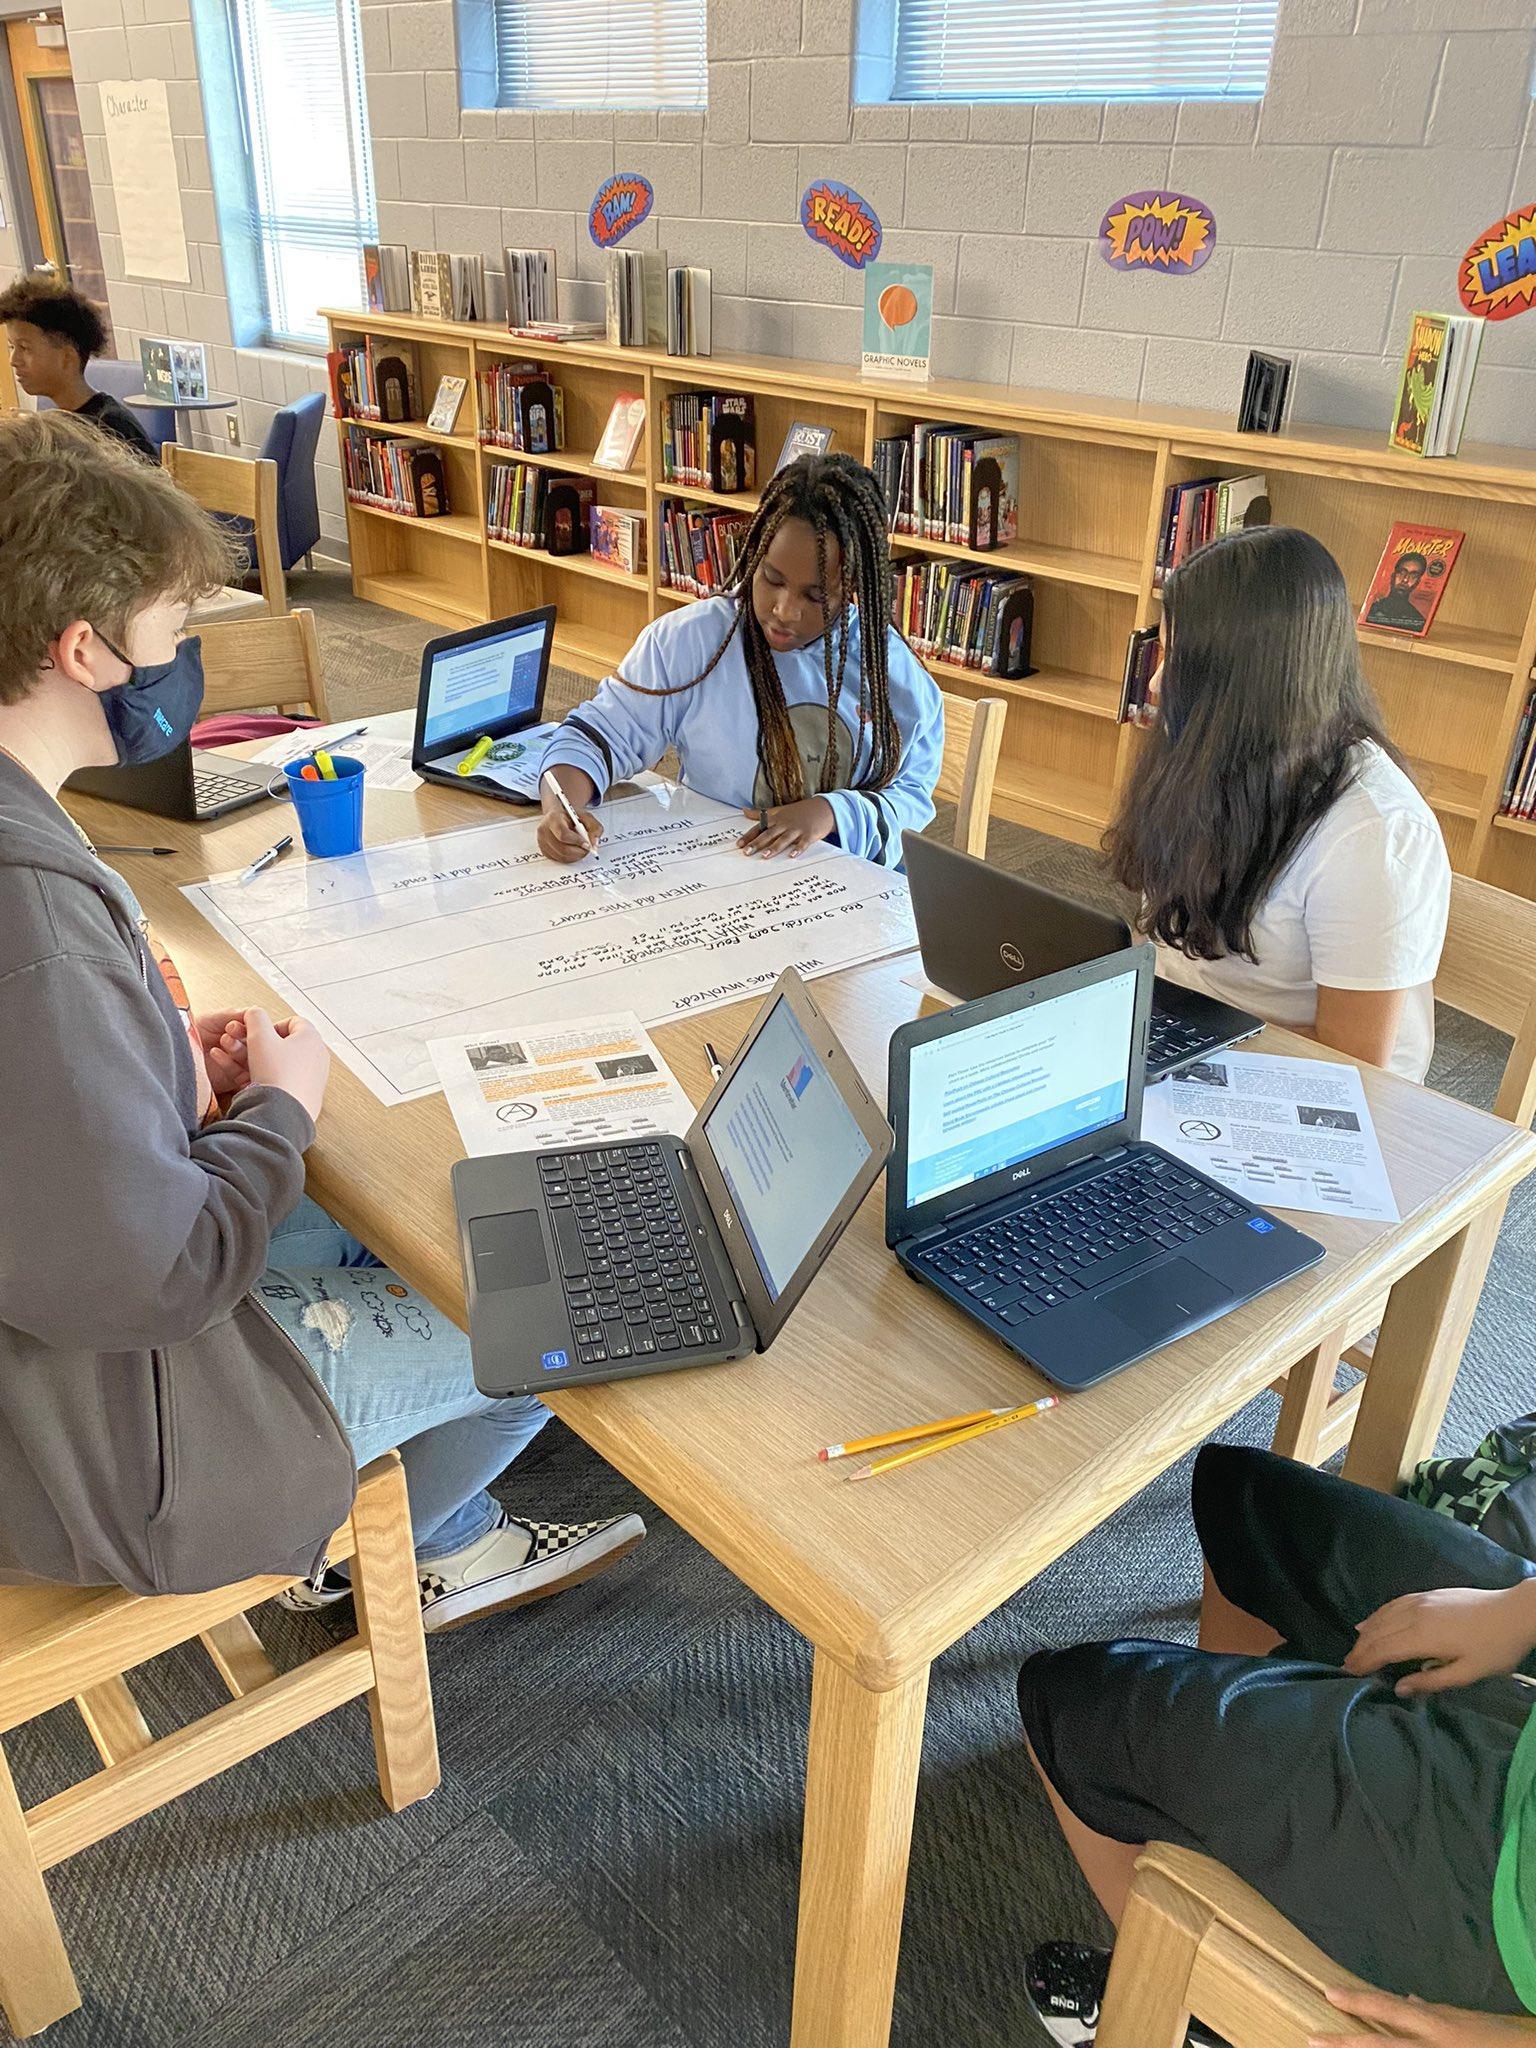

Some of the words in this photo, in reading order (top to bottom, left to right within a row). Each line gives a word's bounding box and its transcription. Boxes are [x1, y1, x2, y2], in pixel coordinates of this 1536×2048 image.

[106, 95, 148, 117] Character
[600, 191, 637, 231] BAM!
[813, 195, 873, 251] READ!
[1123, 213, 1187, 254] POW!
[1477, 236, 1536, 295] LEA
[863, 353, 895, 367] GRAPHIC
[896, 357, 927, 368] NOVELS
[722, 404, 747, 415] WARS
[724, 398, 747, 408] STAR
[1392, 538, 1454, 557] MONSTER
[627, 828, 658, 837] was
[658, 819, 694, 832] HOW
[614, 833, 627, 841] it
[475, 858, 511, 871] How
[449, 867, 472, 878] did
[600, 867, 621, 879] did
[393, 876, 427, 889] end?
[658, 882, 708, 899] WHEN
[598, 901, 632, 913] this
[633, 895, 656, 909] did
[840, 902, 864, 914] Red
[549, 909, 597, 927] occur?
[1002, 950, 1022, 965] DELL
[794, 959, 824, 972] WH
[746, 971, 779, 989] was
[671, 981, 748, 1009] involved?
[1012, 1167, 1031, 1181] DELL
[723, 1209, 733, 1229] DELL
